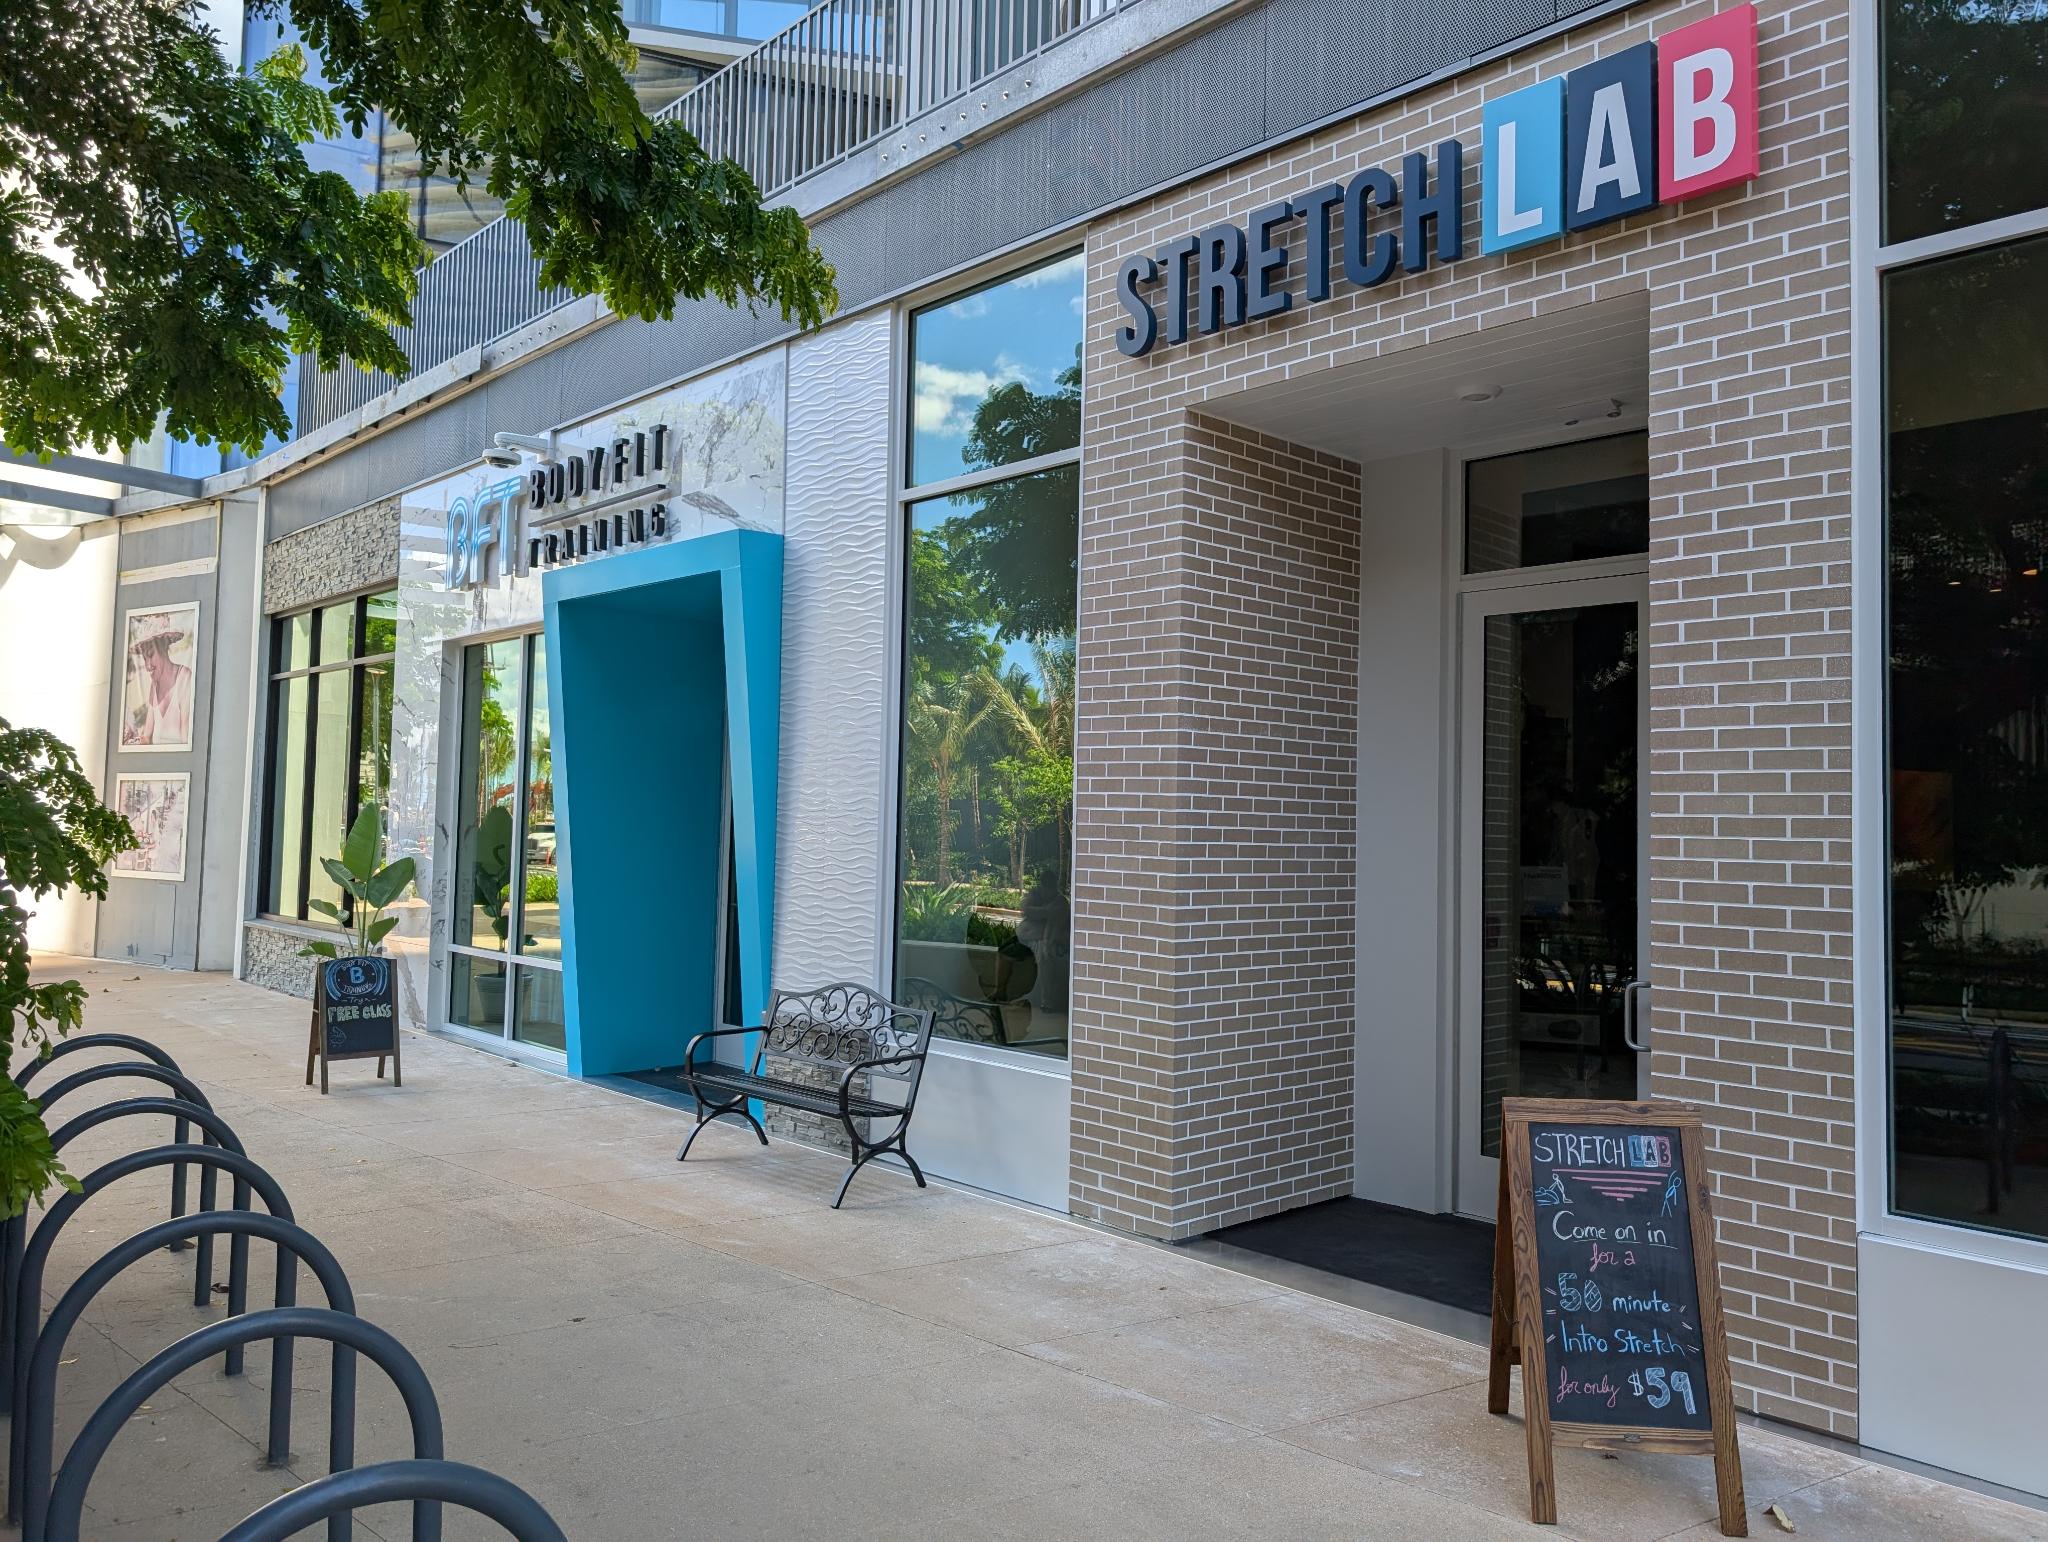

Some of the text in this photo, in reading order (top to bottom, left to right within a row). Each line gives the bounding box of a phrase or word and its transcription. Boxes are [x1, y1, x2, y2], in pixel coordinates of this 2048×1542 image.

[1116, 46, 1738, 358] STRETCH LAB
[446, 475, 528, 590] BFT
[527, 503, 666, 569] TRAINING
[327, 1003, 392, 1023] FREE CLASS
[1534, 1133, 1671, 1168] STRETCH LAB
[1552, 1210, 1667, 1244] Come on in
[1590, 1243, 1636, 1272] for a
[1558, 1272, 1671, 1314] 50 minute
[1561, 1319, 1686, 1357] Intro Stretch
[1556, 1365, 1697, 1416] for only $59
